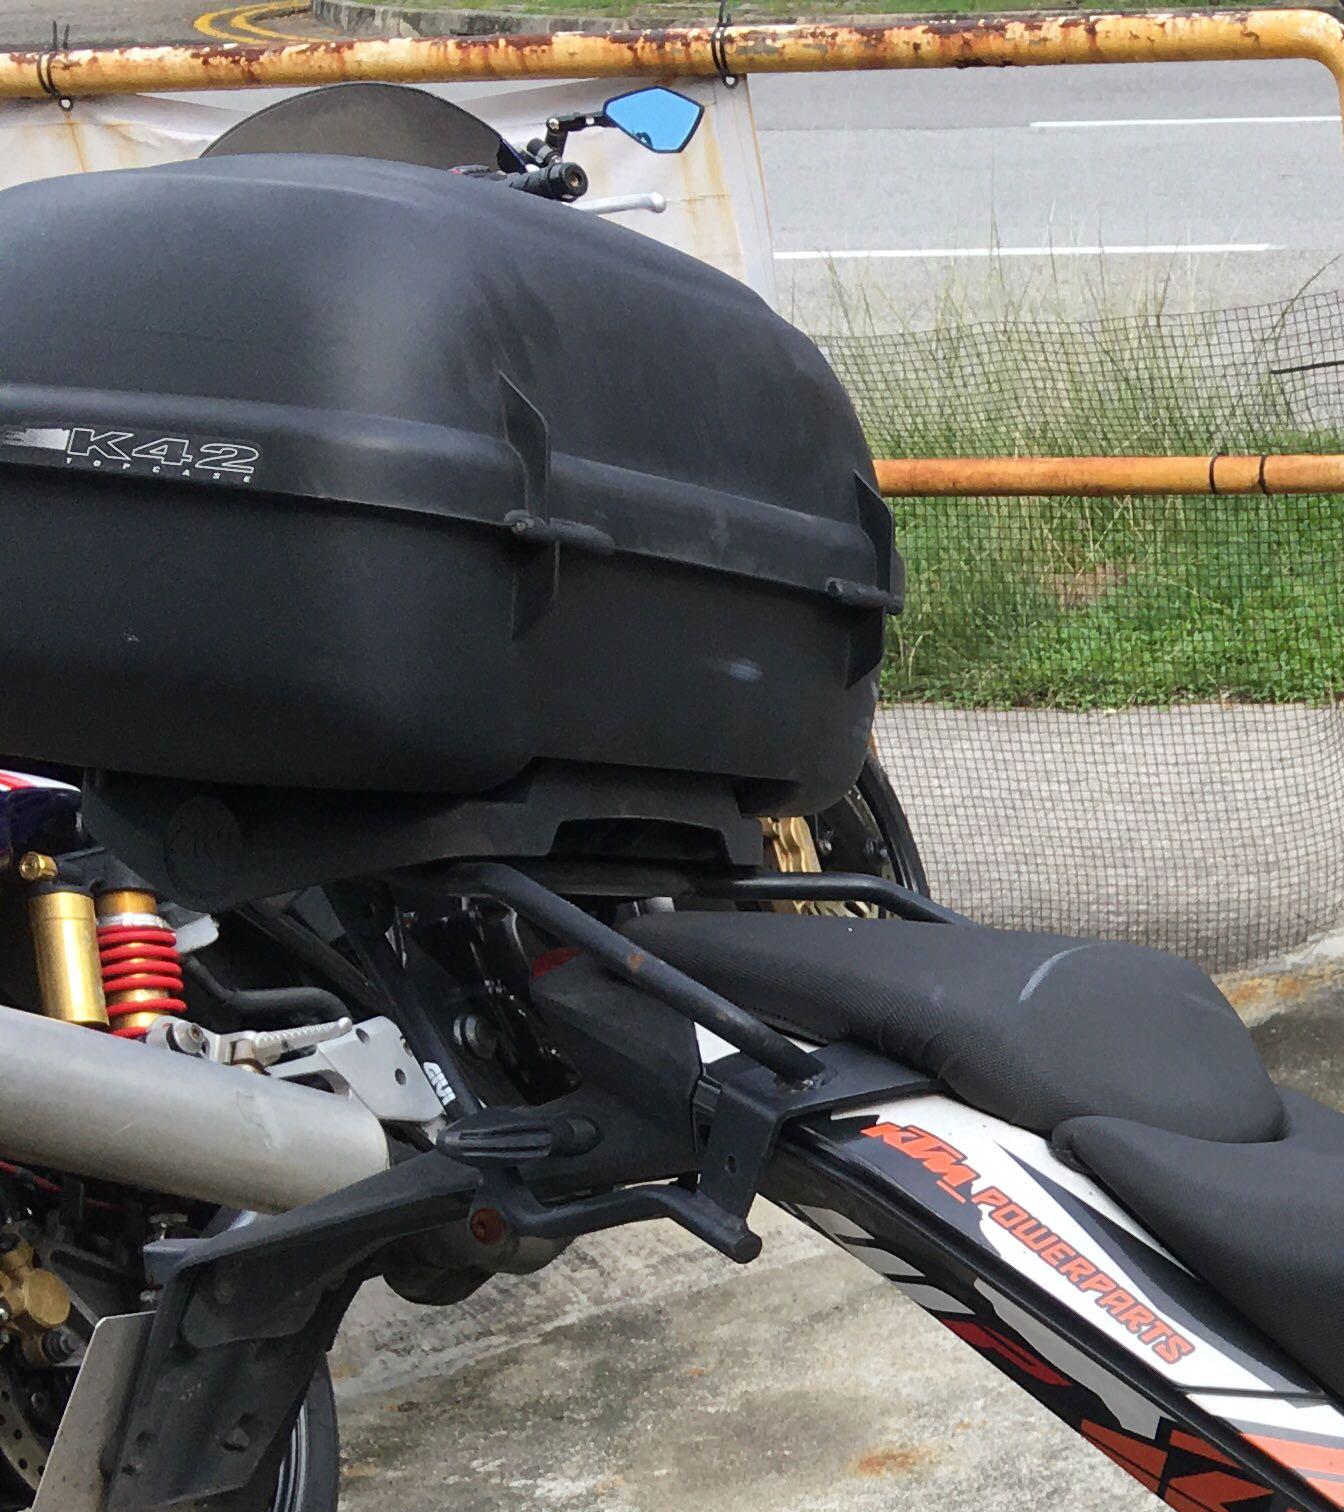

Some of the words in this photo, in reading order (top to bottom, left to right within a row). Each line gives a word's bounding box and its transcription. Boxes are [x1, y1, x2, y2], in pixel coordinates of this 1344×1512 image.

[67, 427, 259, 474] K42
[423, 1061, 456, 1106] GIVI
[861, 1121, 980, 1202] KTM
[973, 1187, 1197, 1364] POWERPARTS
